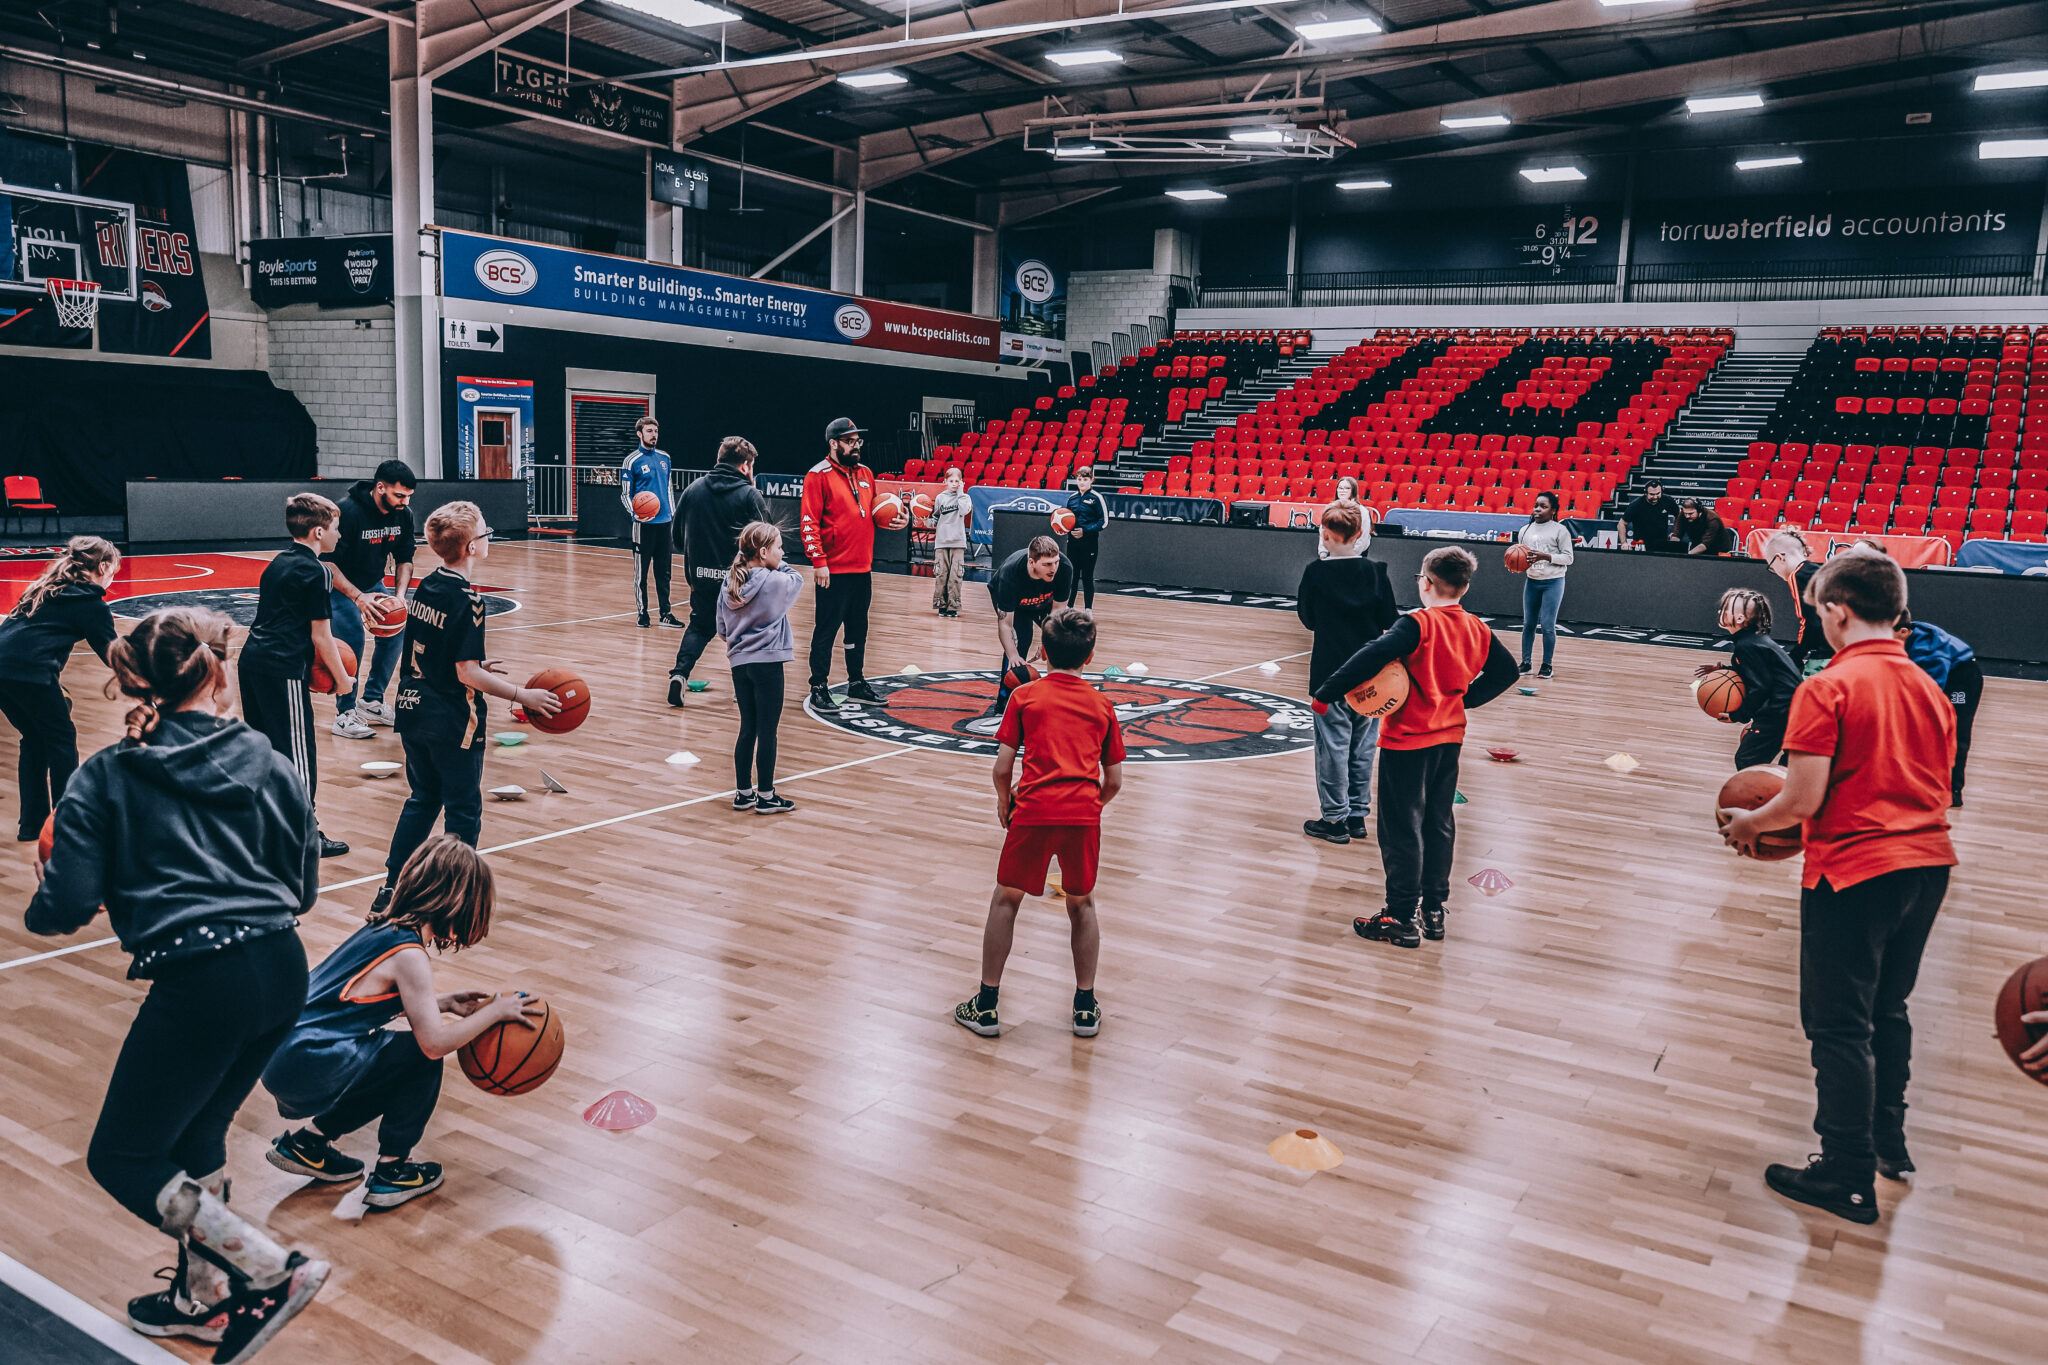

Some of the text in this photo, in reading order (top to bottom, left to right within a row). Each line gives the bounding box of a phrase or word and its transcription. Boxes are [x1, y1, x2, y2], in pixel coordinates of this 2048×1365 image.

[498, 60, 570, 98] TIGER
[546, 97, 563, 109] ALE
[632, 104, 664, 121] OFFICIAL
[639, 118, 658, 129] BEER
[655, 162, 709, 182] HOME GUESTS
[689, 181, 695, 191] 3
[1535, 224, 1546, 239] 6
[1562, 216, 1599, 245] 12
[1660, 210, 2006, 242] torrwaterfield accountants
[1541, 246, 1555, 265] 9
[258, 259, 317, 277] BoyleSports
[349, 260, 372, 268] WORLD
[349, 268, 373, 276] GRAND
[269, 276, 317, 287] THIS IS BETTING
[354, 276, 369, 285] PRIX
[488, 264, 521, 285] BCS
[573, 265, 635, 289] Smarter
[767, 294, 808, 318] Energy
[1023, 274, 1045, 293] BCS
[574, 288, 808, 329] BUILDING MANAGEMENT SYSTEMS
[840, 315, 863, 330] BCS
[884, 320, 991, 347] www.bcspecialists.com
[447, 340, 471, 349] TOILETS
[1018, 501, 1047, 511] 360
[1950, 691, 1966, 704] 32
